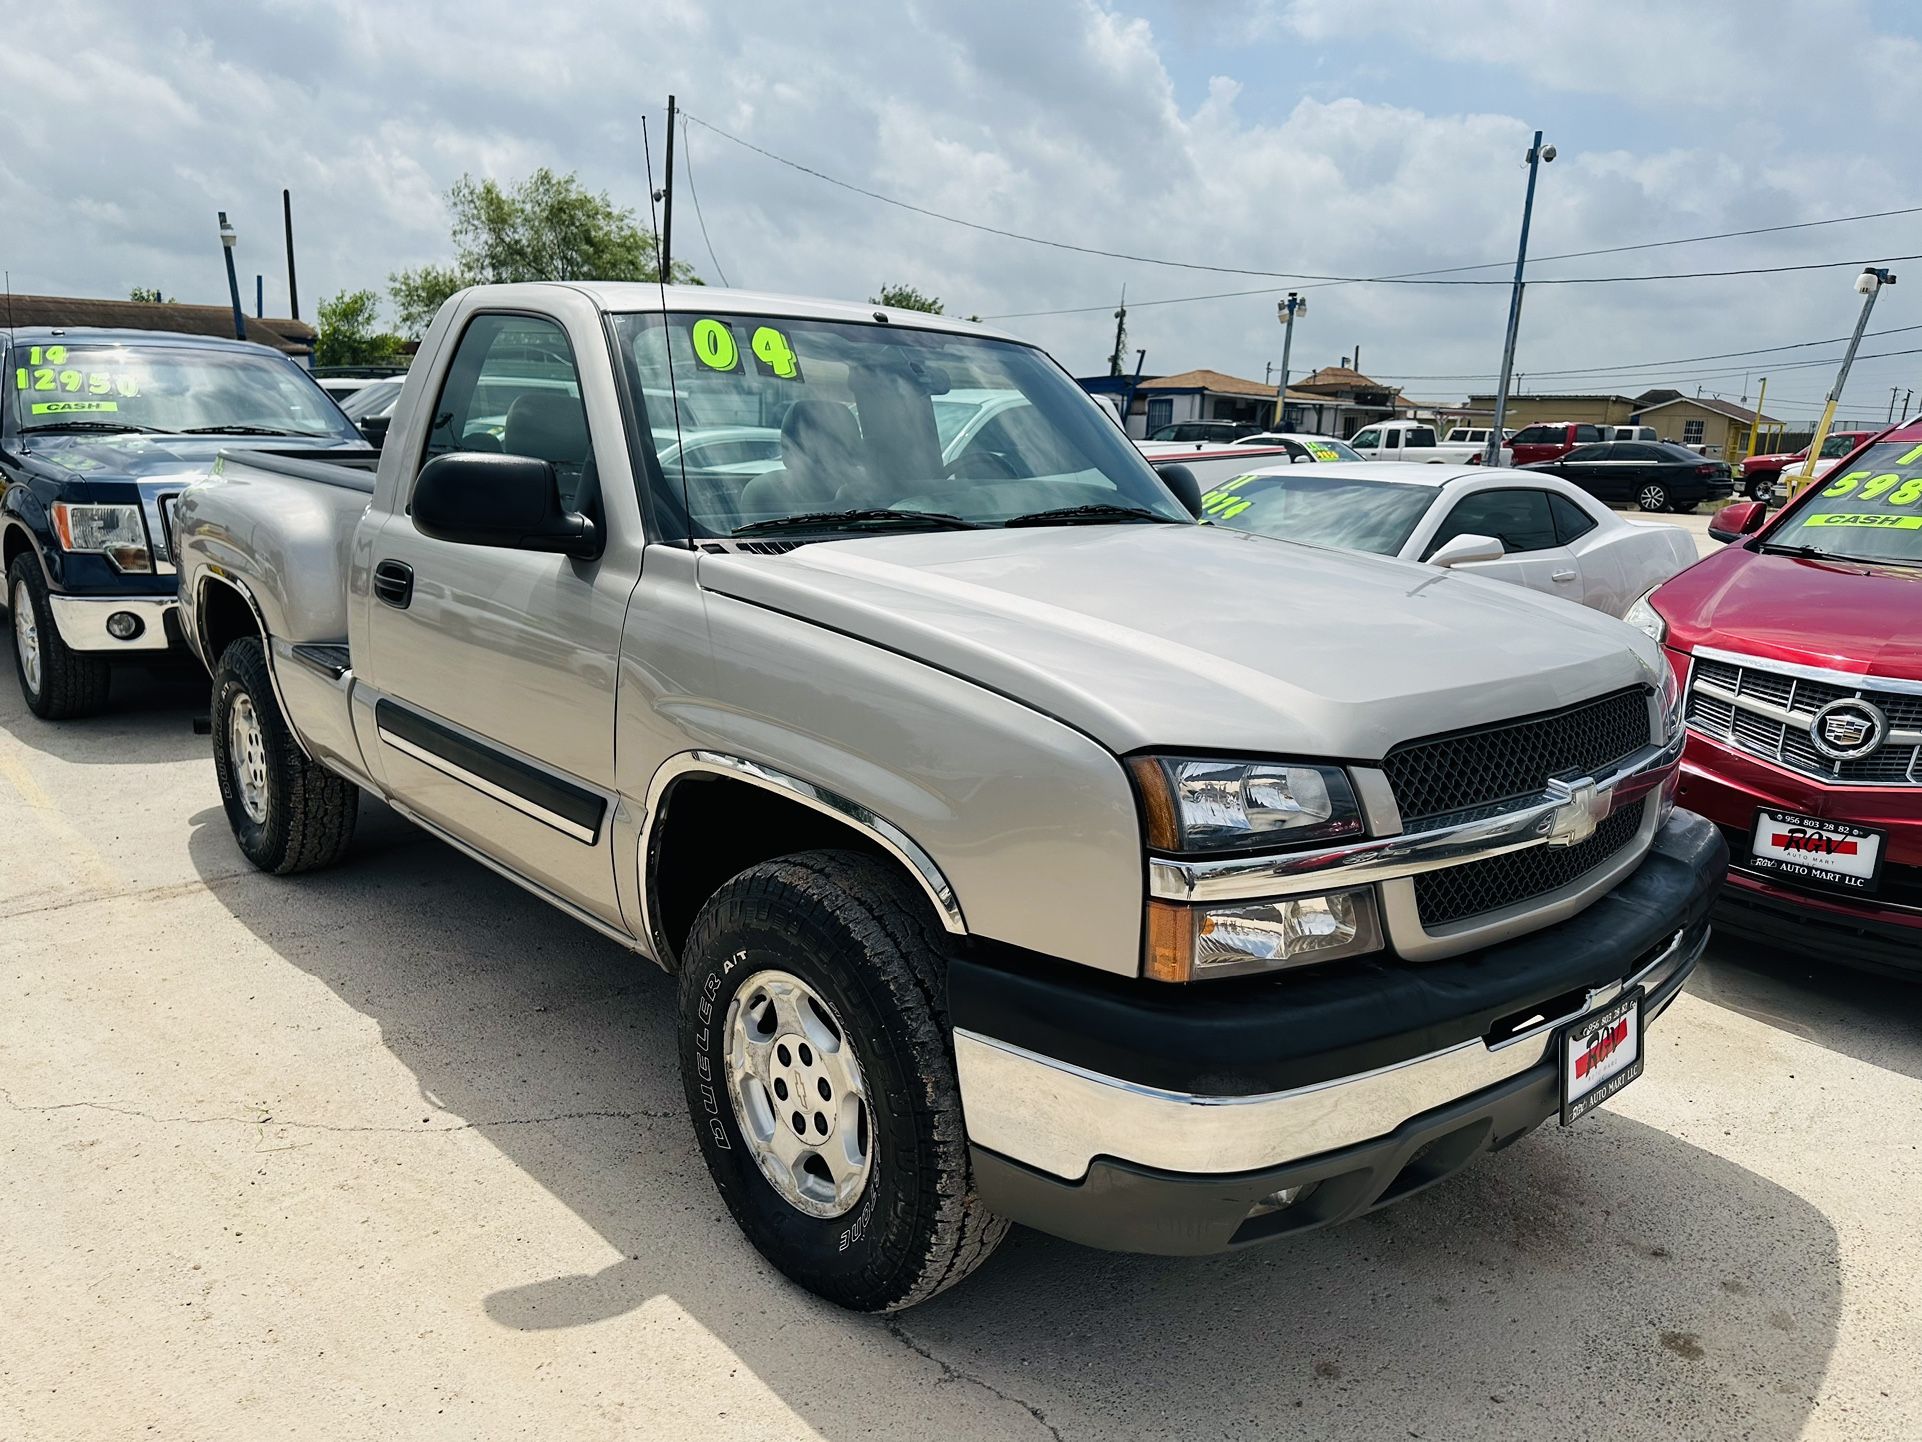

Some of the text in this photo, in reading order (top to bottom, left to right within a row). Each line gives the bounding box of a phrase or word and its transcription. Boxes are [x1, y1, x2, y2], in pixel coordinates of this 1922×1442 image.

[30, 346, 69, 365] 14
[693, 319, 797, 378] 04
[16, 368, 141, 397] 12950
[46, 403, 101, 411] CASH
[1824, 515, 1904, 525] CASH
[1784, 815, 1850, 833] 956 803 28 82
[1783, 827, 1849, 855] RGV
[1780, 863, 1808, 875] AUTO
[1811, 869, 1842, 882] MART
[1845, 877, 1865, 887] LLC
[723, 950, 747, 974] A/T
[697, 972, 731, 1150] DUELER
[1589, 1087, 1607, 1108] AUTO
[1608, 1074, 1626, 1095] MART
[1627, 1064, 1638, 1080] LLC
